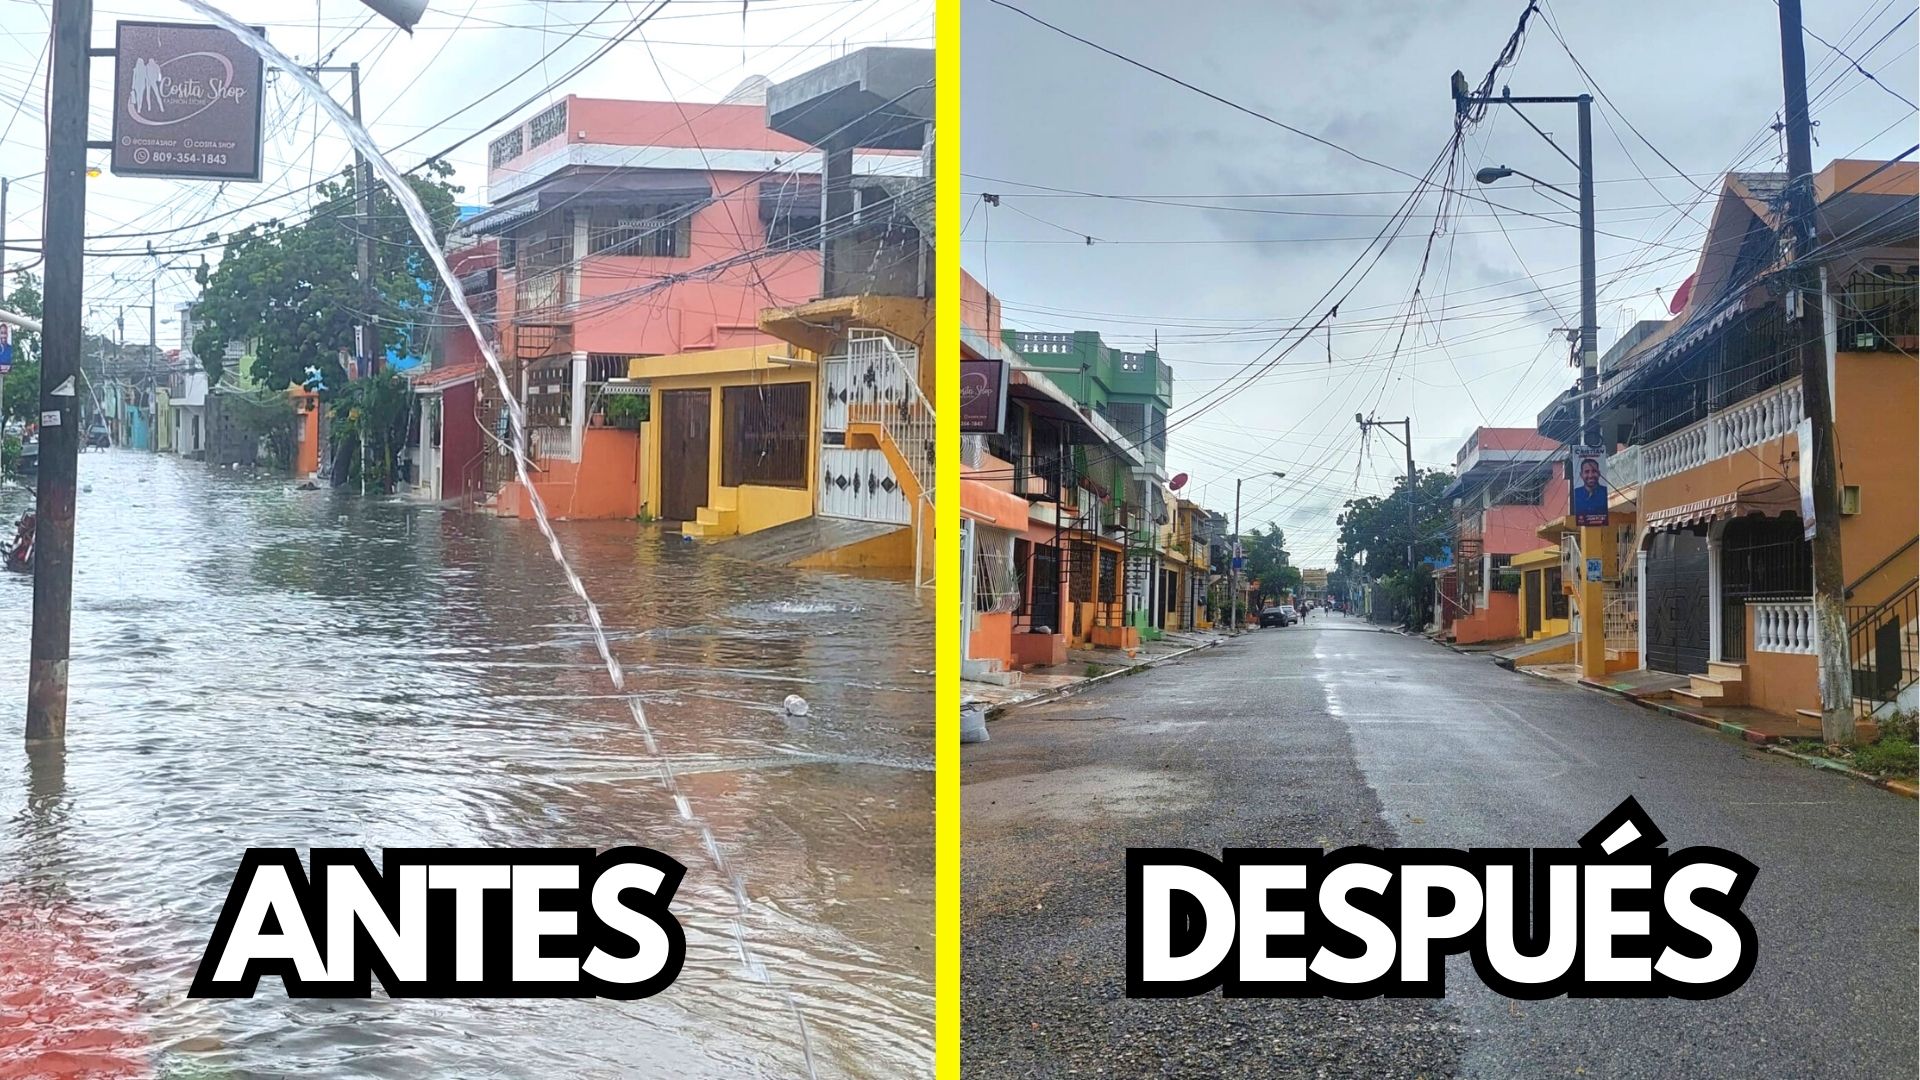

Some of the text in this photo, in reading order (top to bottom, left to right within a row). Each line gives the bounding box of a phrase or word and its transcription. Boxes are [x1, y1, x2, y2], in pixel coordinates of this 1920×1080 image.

[160, 76, 248, 104] Cosita Shop
[194, 140, 217, 149] COSITA
[152, 151, 227, 165] 809-354-1843
